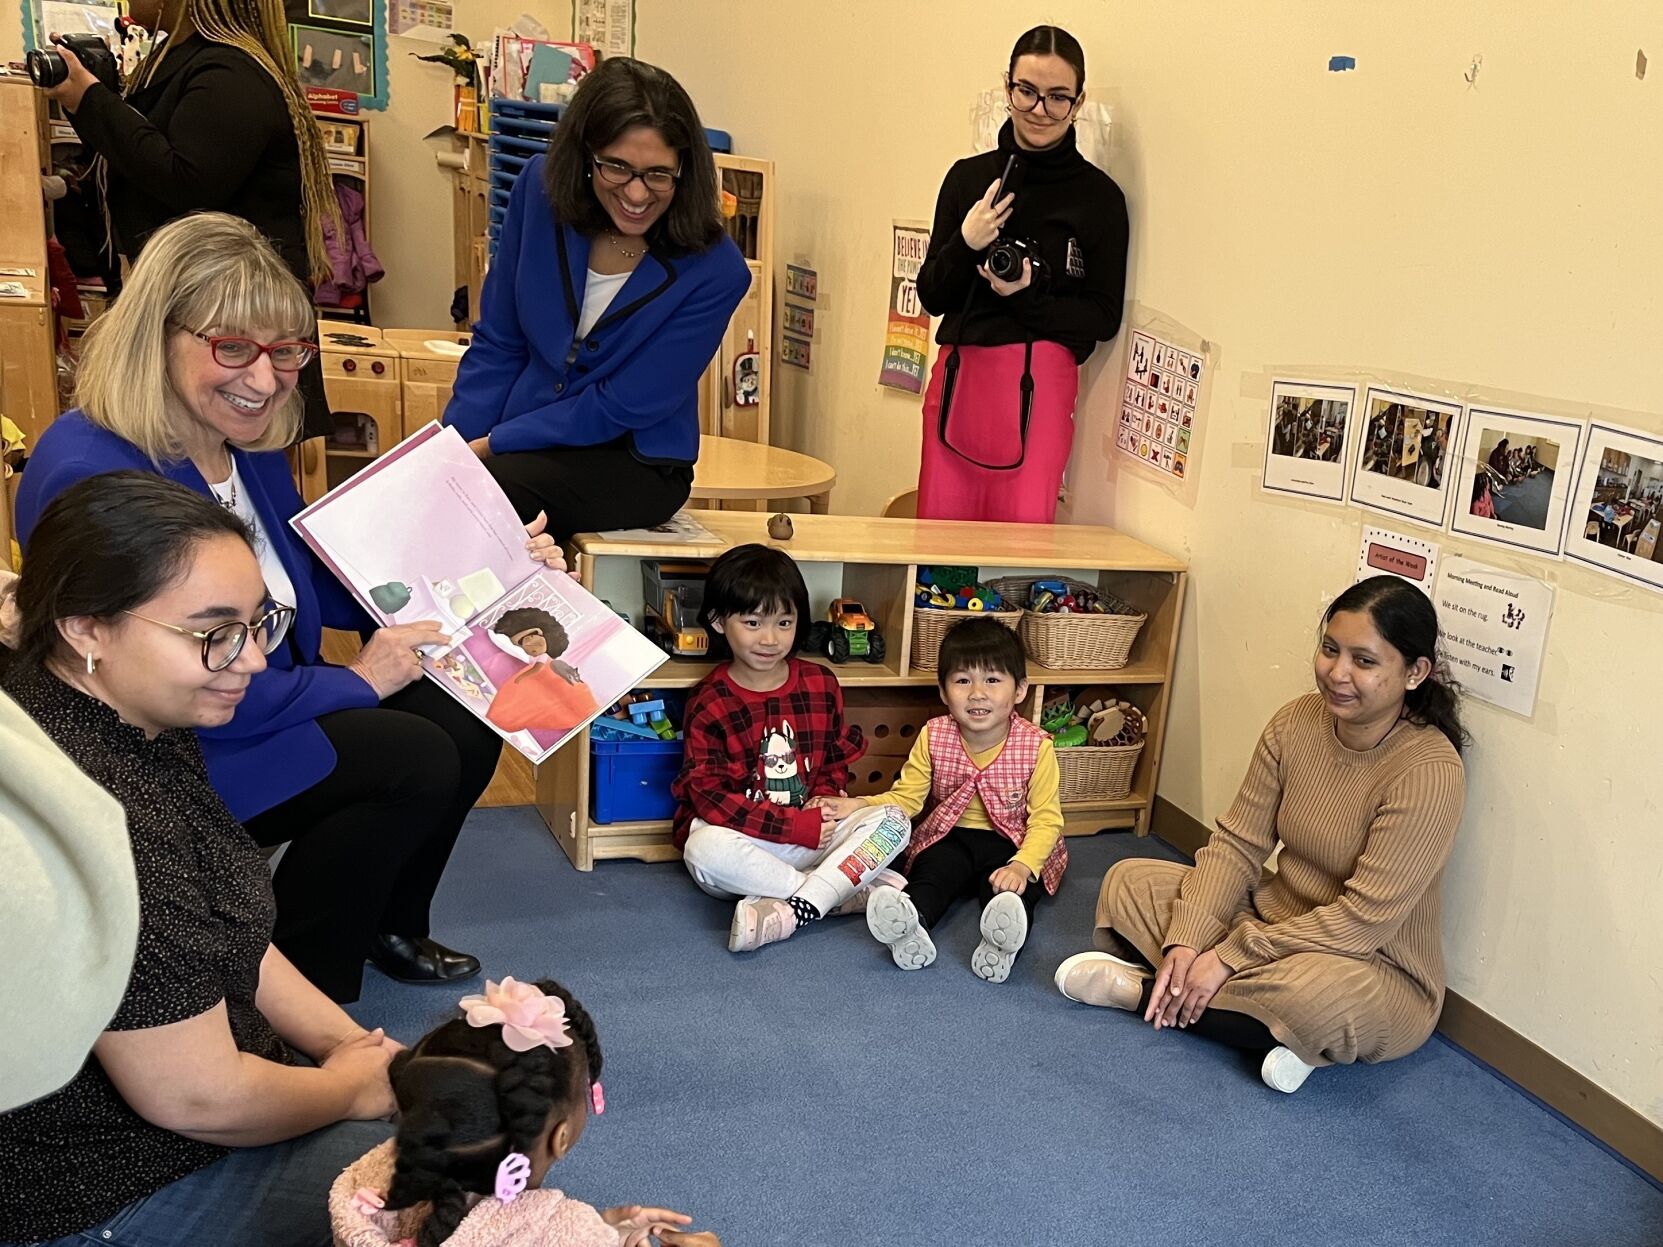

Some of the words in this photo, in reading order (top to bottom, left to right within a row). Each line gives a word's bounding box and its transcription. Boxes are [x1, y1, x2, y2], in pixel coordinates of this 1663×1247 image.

[897, 235, 921, 260] BELIEVE
[897, 258, 906, 273] THE
[907, 259, 922, 275] POW
[901, 284, 917, 315] YET
[1447, 572, 1465, 584] Morning
[1465, 577, 1483, 590] Meeting
[1492, 585, 1505, 595] Read
[1504, 589, 1519, 599] Aloud
[1442, 600, 1451, 609] We
[1451, 603, 1459, 612] sit
[1459, 606, 1467, 614] on
[1467, 608, 1477, 618] the
[1446, 631, 1459, 643] look
[1459, 637, 1465, 645] at
[1465, 638, 1475, 649] the
[1459, 659, 1472, 667] with
[1472, 663, 1482, 673] my
